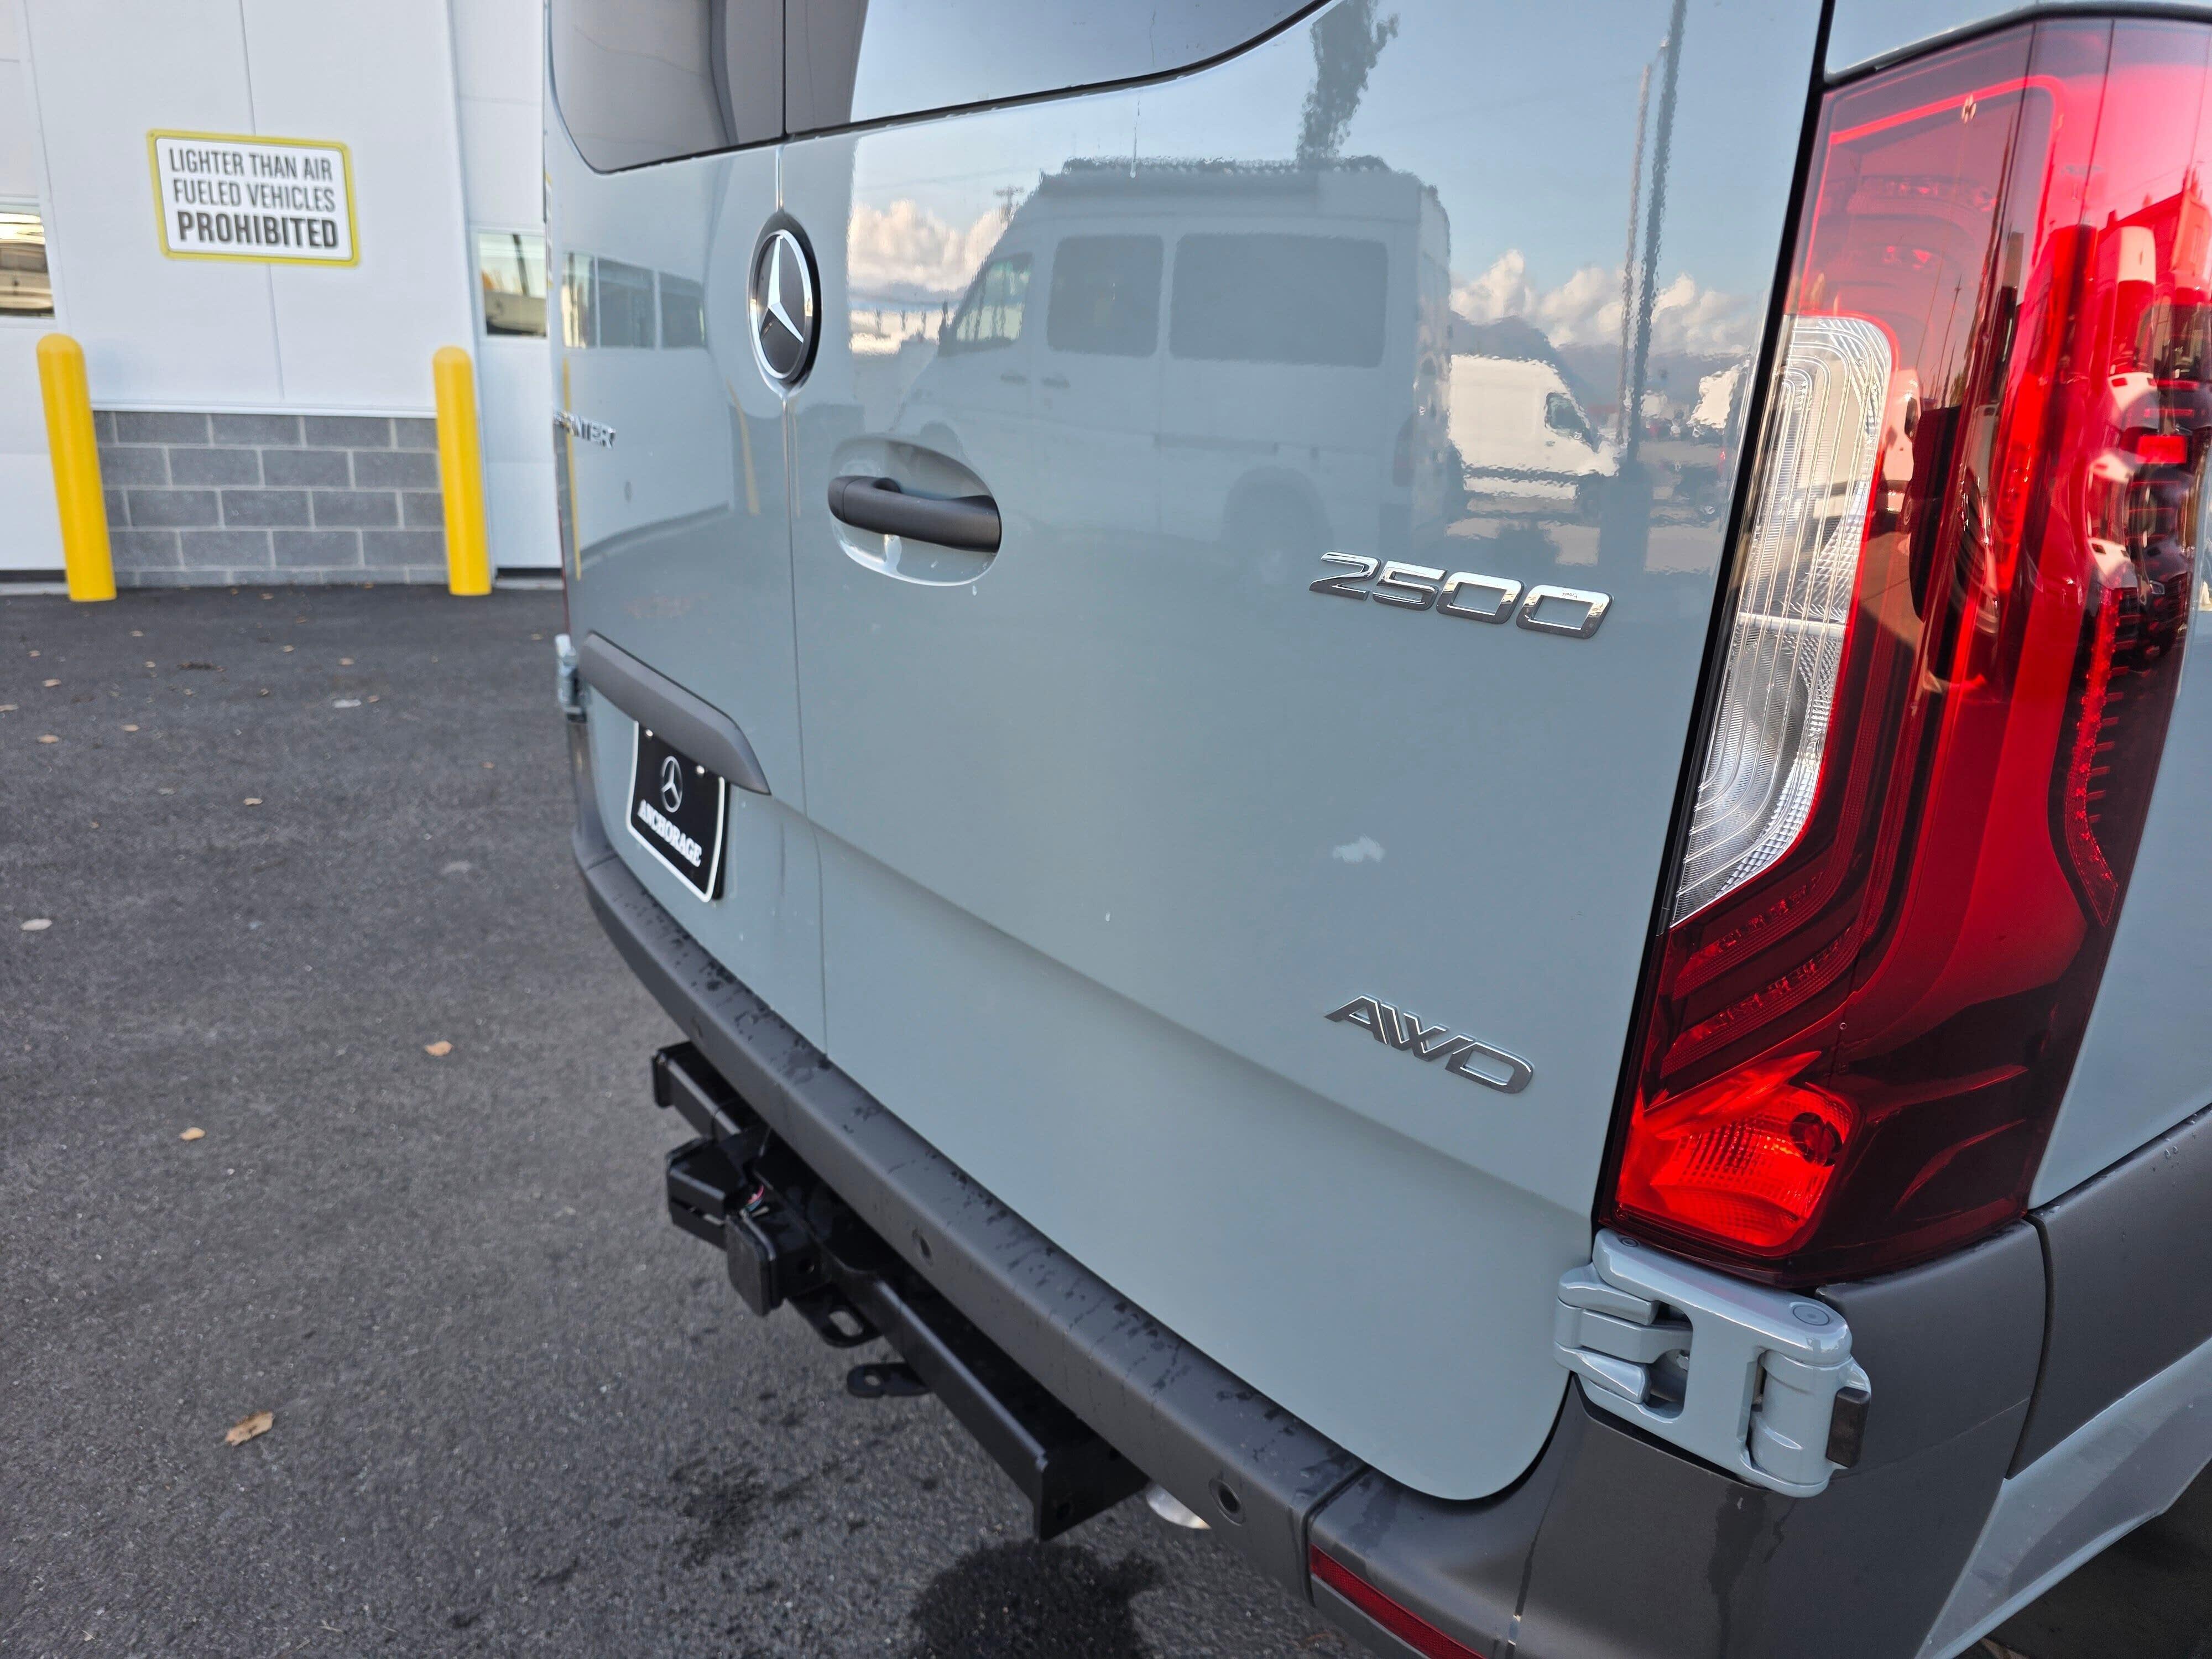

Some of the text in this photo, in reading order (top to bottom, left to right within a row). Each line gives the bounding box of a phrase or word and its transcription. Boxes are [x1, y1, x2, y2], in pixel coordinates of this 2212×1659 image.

[169, 148, 333, 182] LIGHTER THAN AIR
[173, 178, 336, 212] FUELED VEHICLES
[177, 210, 339, 249] PROHIBITED
[1309, 551, 1613, 639] 2500
[637, 799, 702, 868] ANCHORAGE
[1323, 994, 1534, 1094] AWD
